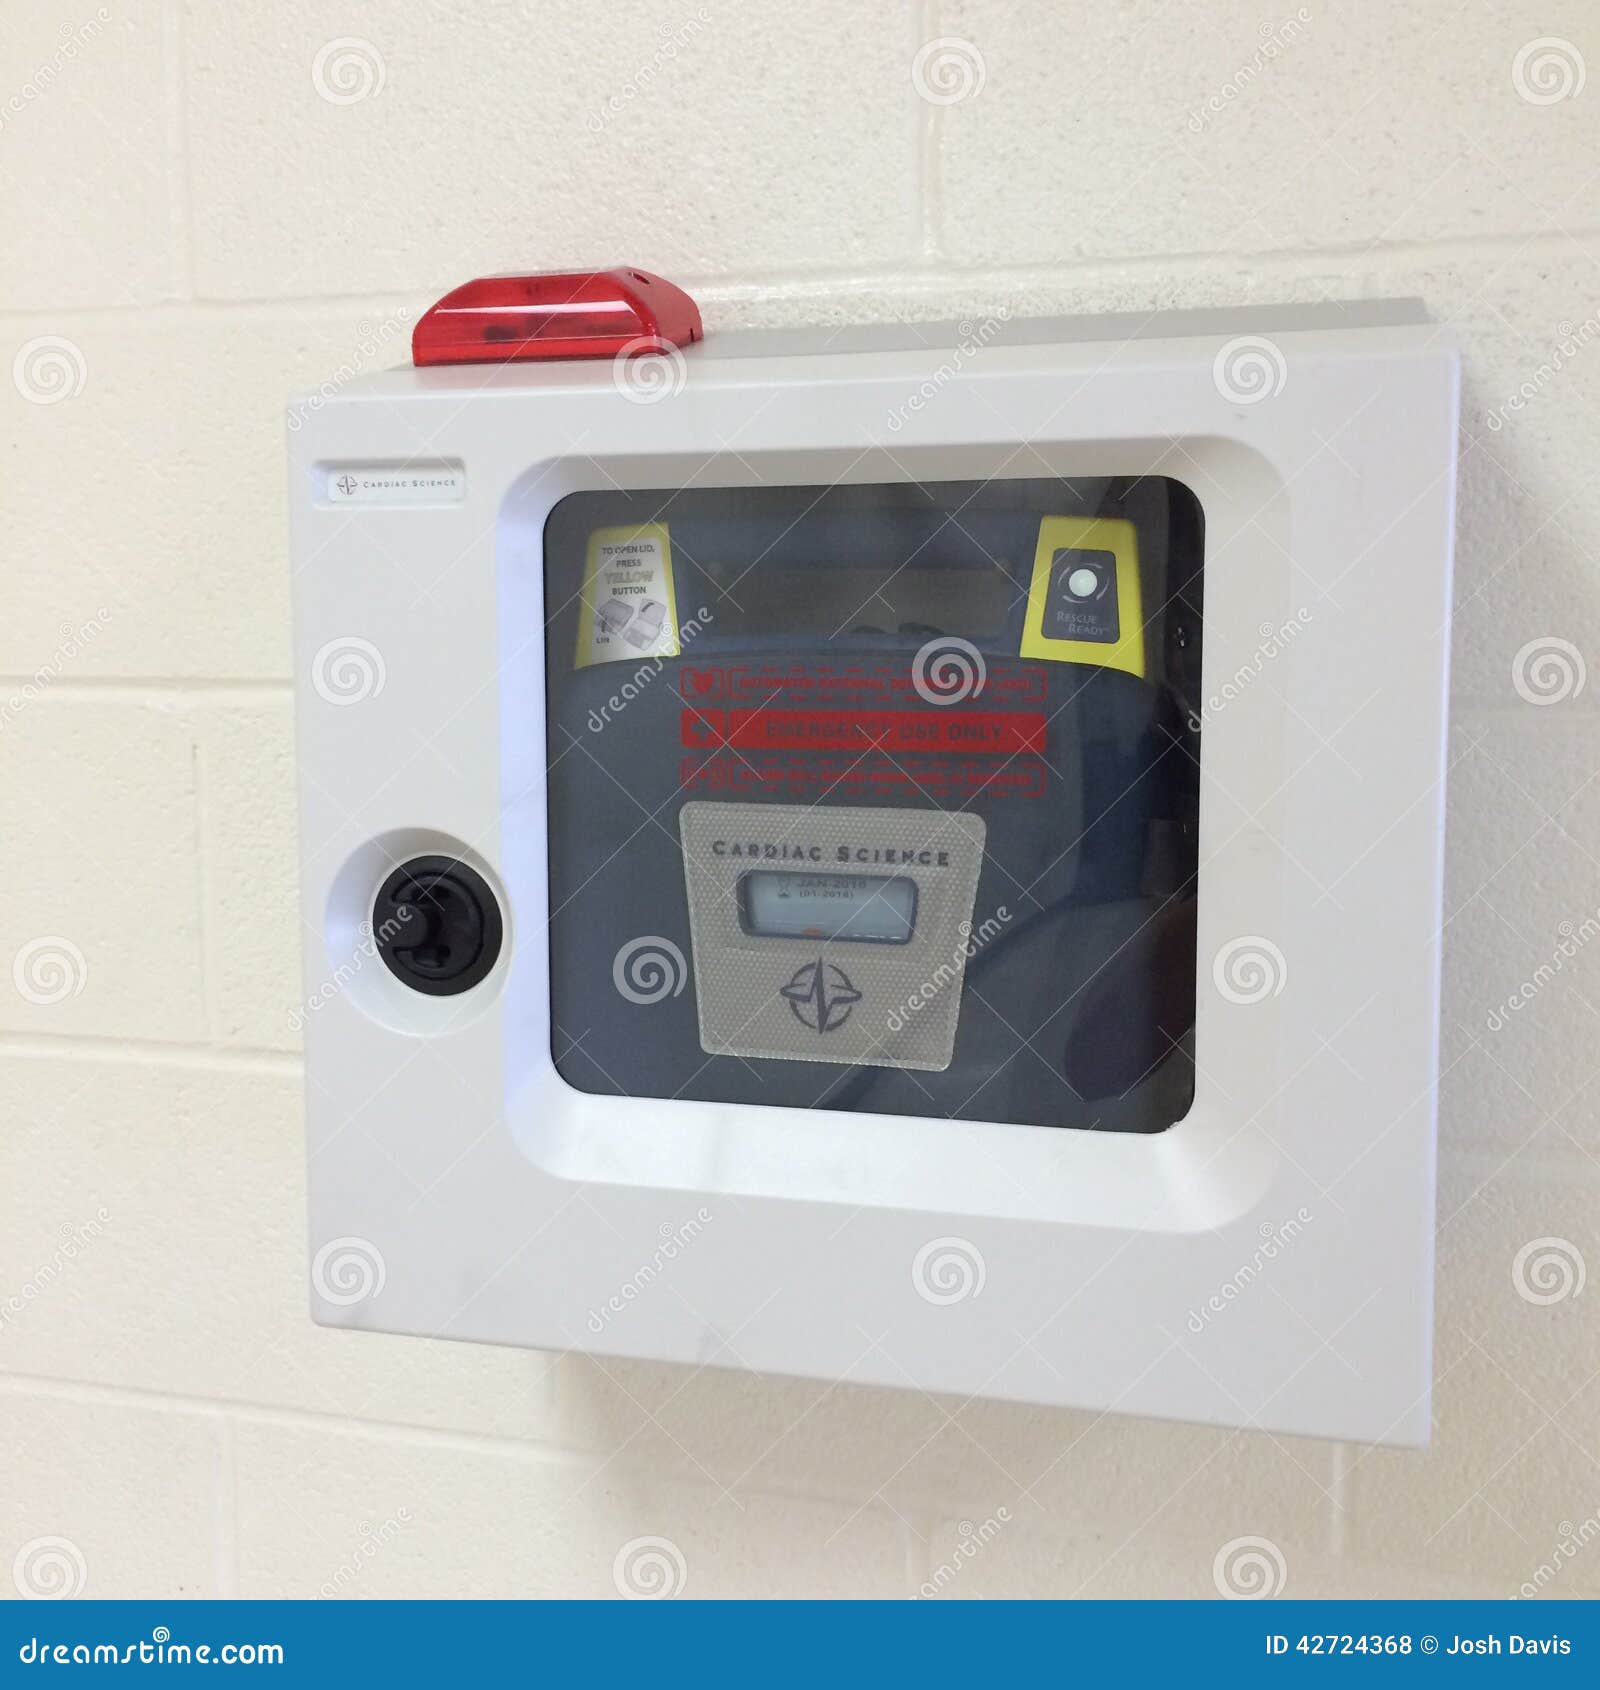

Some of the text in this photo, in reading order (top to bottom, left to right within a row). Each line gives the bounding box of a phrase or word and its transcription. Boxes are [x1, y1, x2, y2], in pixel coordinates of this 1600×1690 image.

[602, 547, 613, 555] TO
[616, 559, 642, 568] PRESS
[604, 570, 654, 585] YELLOW
[612, 586, 647, 596] BUTTON
[1057, 611, 1097, 624] RESCUE
[766, 720, 1003, 741] EMERGENCY USE ONLY
[712, 840, 949, 867] CARDIAC SCIENCE
